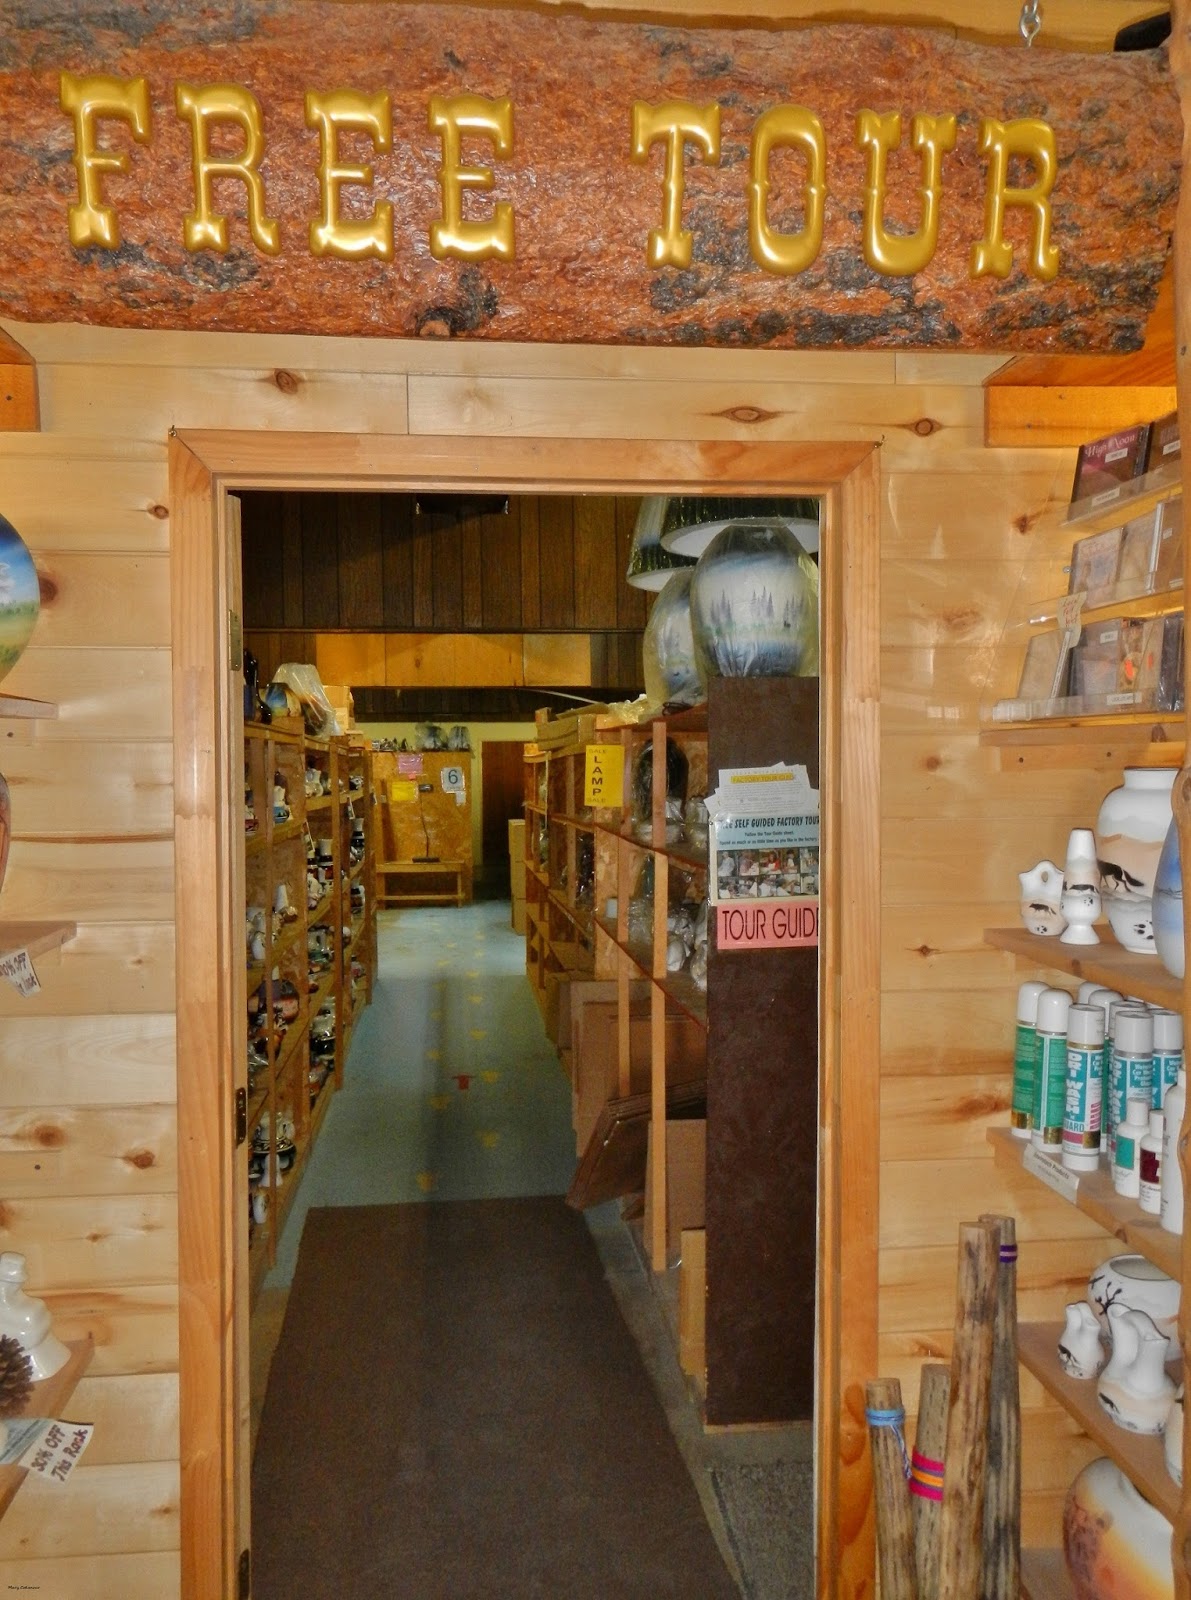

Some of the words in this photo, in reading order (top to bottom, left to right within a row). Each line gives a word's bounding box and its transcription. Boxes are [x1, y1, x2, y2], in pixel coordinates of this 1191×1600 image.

[59, 69, 516, 263] FREE
[630, 101, 1061, 282] TOUR
[448, 769, 459, 785] 6
[591, 755, 603, 796] LAMP
[734, 818, 750, 829] SELF
[751, 817, 775, 828] GUIDED
[776, 816, 803, 827] FACTORY
[722, 909, 766, 940] TOUR
[772, 907, 819, 939] GUID
[31, 1448, 54, 1472] 30%
[45, 1424, 66, 1449] OFF
[50, 1459, 72, 1482] This
[63, 1429, 88, 1458] Rack
